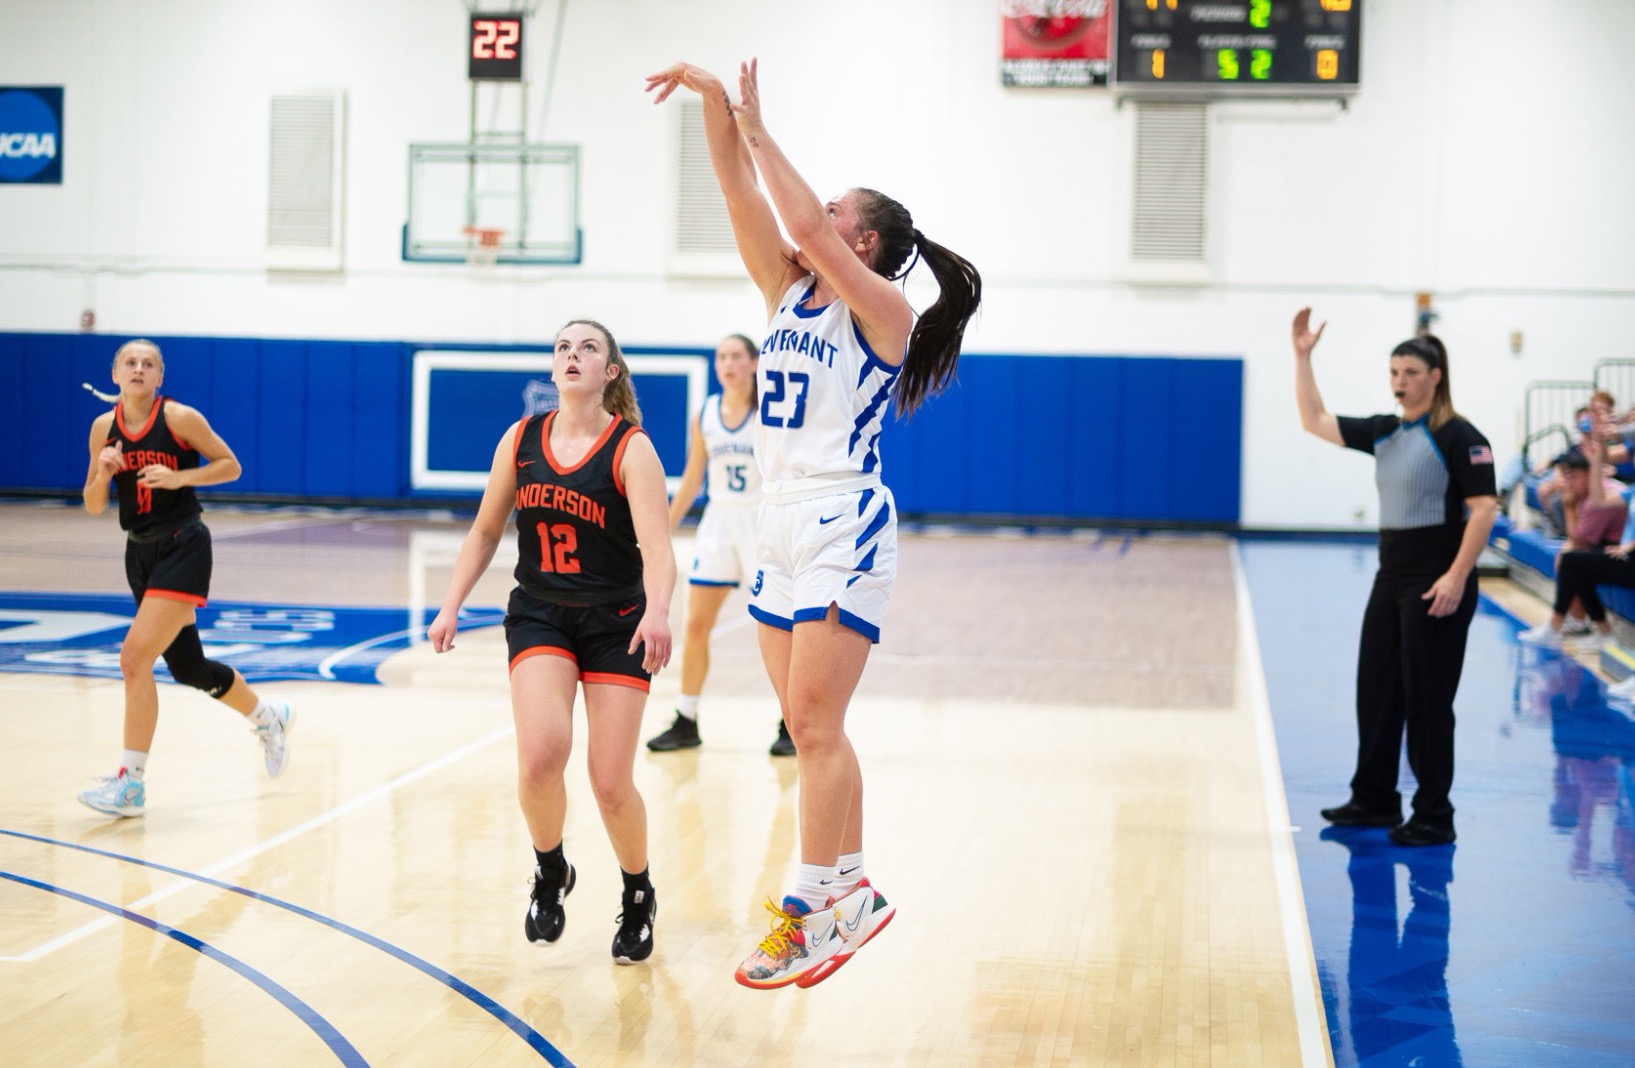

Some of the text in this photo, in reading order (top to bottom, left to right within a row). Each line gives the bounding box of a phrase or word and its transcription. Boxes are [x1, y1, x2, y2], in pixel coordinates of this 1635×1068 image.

[473, 20, 520, 59] 22
[761, 369, 810, 429] 23
[726, 465, 747, 492] 15
[536, 521, 581, 574] 12
